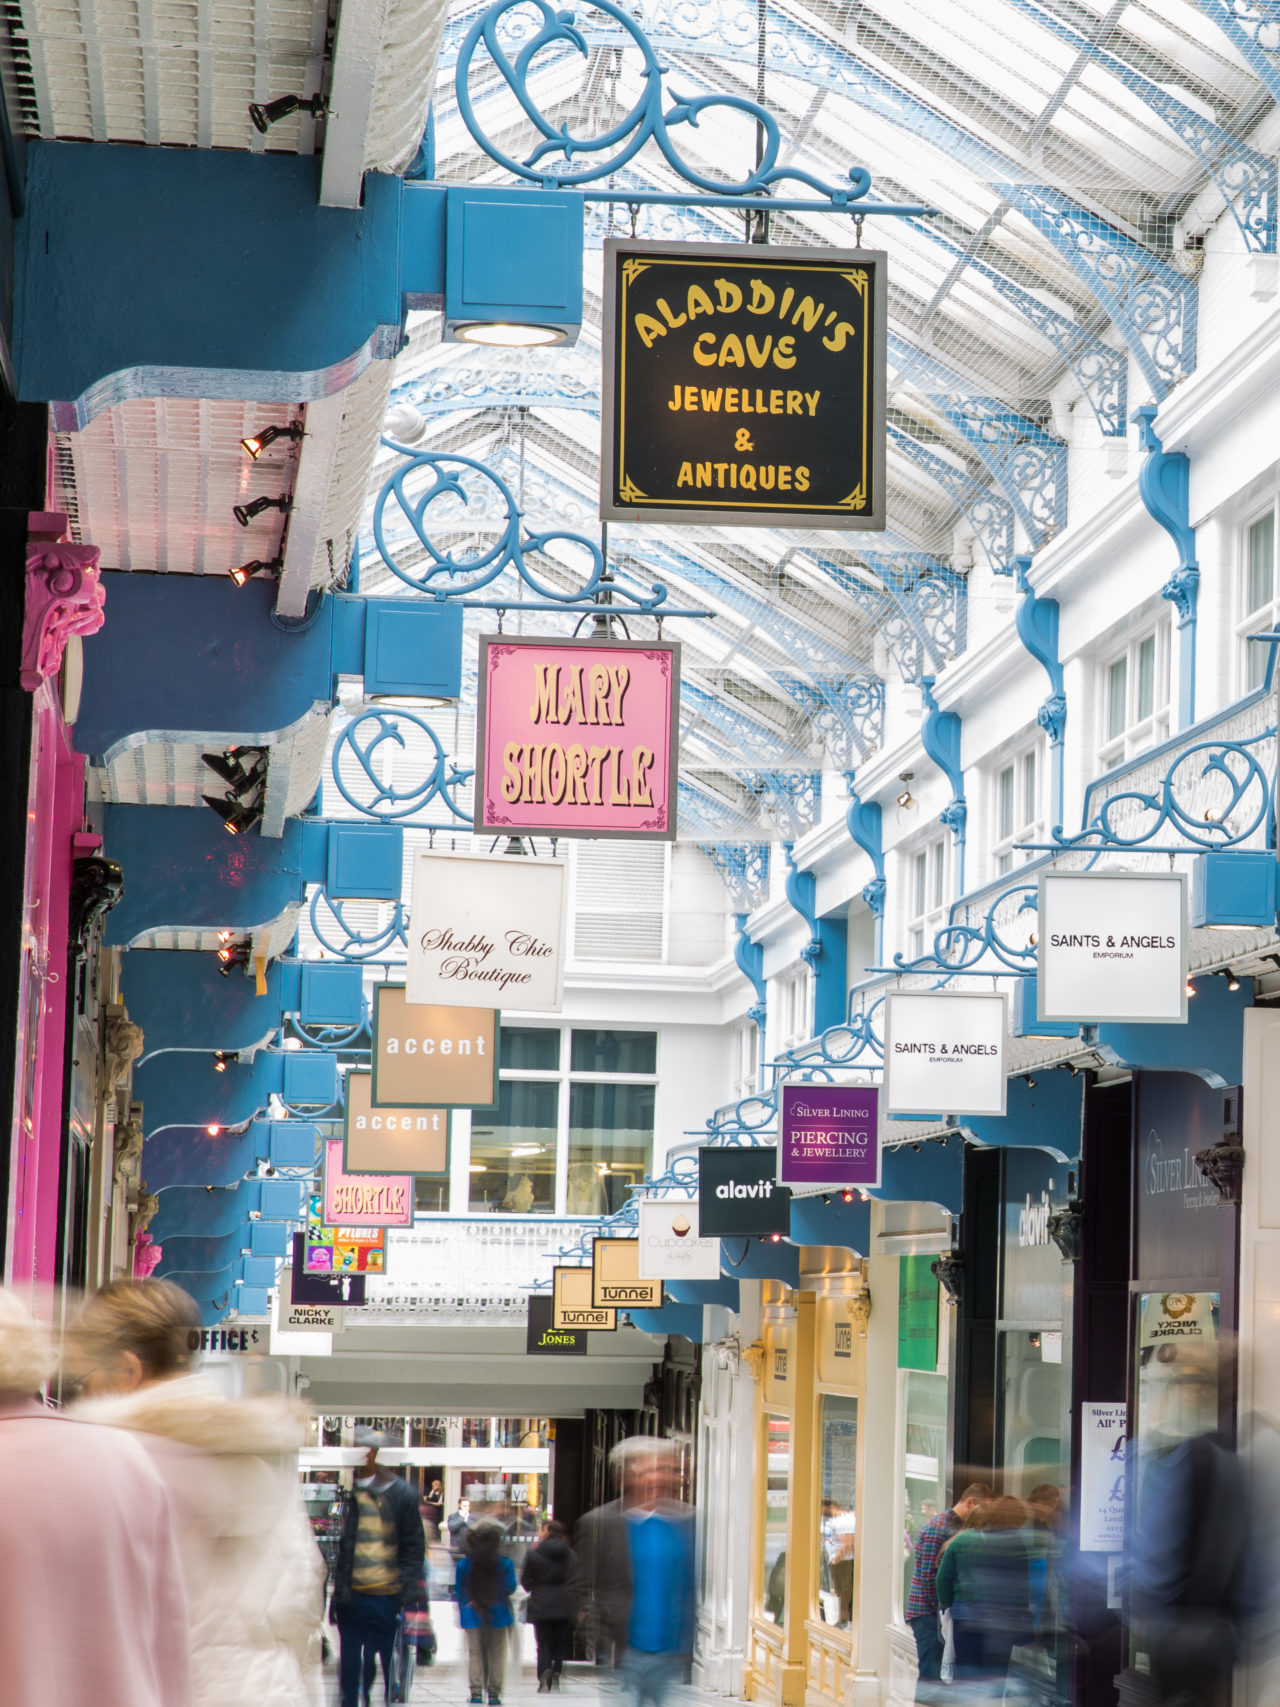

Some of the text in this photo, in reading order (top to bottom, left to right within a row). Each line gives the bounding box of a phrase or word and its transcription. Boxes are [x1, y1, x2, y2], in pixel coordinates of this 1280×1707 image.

[634, 278, 855, 352] ALADDIN'S
[693, 332, 797, 370] CAVE
[668, 384, 821, 417] JEWELLERY
[734, 427, 754, 451] &
[677, 461, 810, 491] ANTIQUES
[529, 663, 631, 726] MARY
[501, 741, 655, 808] SHORTLE
[420, 927, 553, 963] Shabby Chic
[1051, 934, 1176, 949] SAINTS & ANGELS
[1092, 951, 1134, 959] EMPORIUM
[438, 955, 532, 991] Boutique
[386, 1035, 486, 1056] accent
[894, 1042, 998, 1056] SAINTS & ANGELS
[356, 1113, 439, 1131] accent
[796, 1107, 869, 1118] SILVER LINING
[790, 1131, 868, 1145] PIERCING
[791, 1148, 868, 1158] & JEWELLERY
[1151, 1153, 1182, 1194] SILVER
[716, 1180, 773, 1199] alavit
[333, 1185, 405, 1215] SHORTLE
[648, 1236, 713, 1250] Cupcakes
[601, 1287, 653, 1299] Tunnel
[288, 1317, 334, 1325] CLARKE
[294, 1308, 331, 1317] NICKY
[561, 1311, 608, 1322] Tunnel
[187, 1330, 248, 1351] OFFICE
[538, 1333, 576, 1345] JONES
